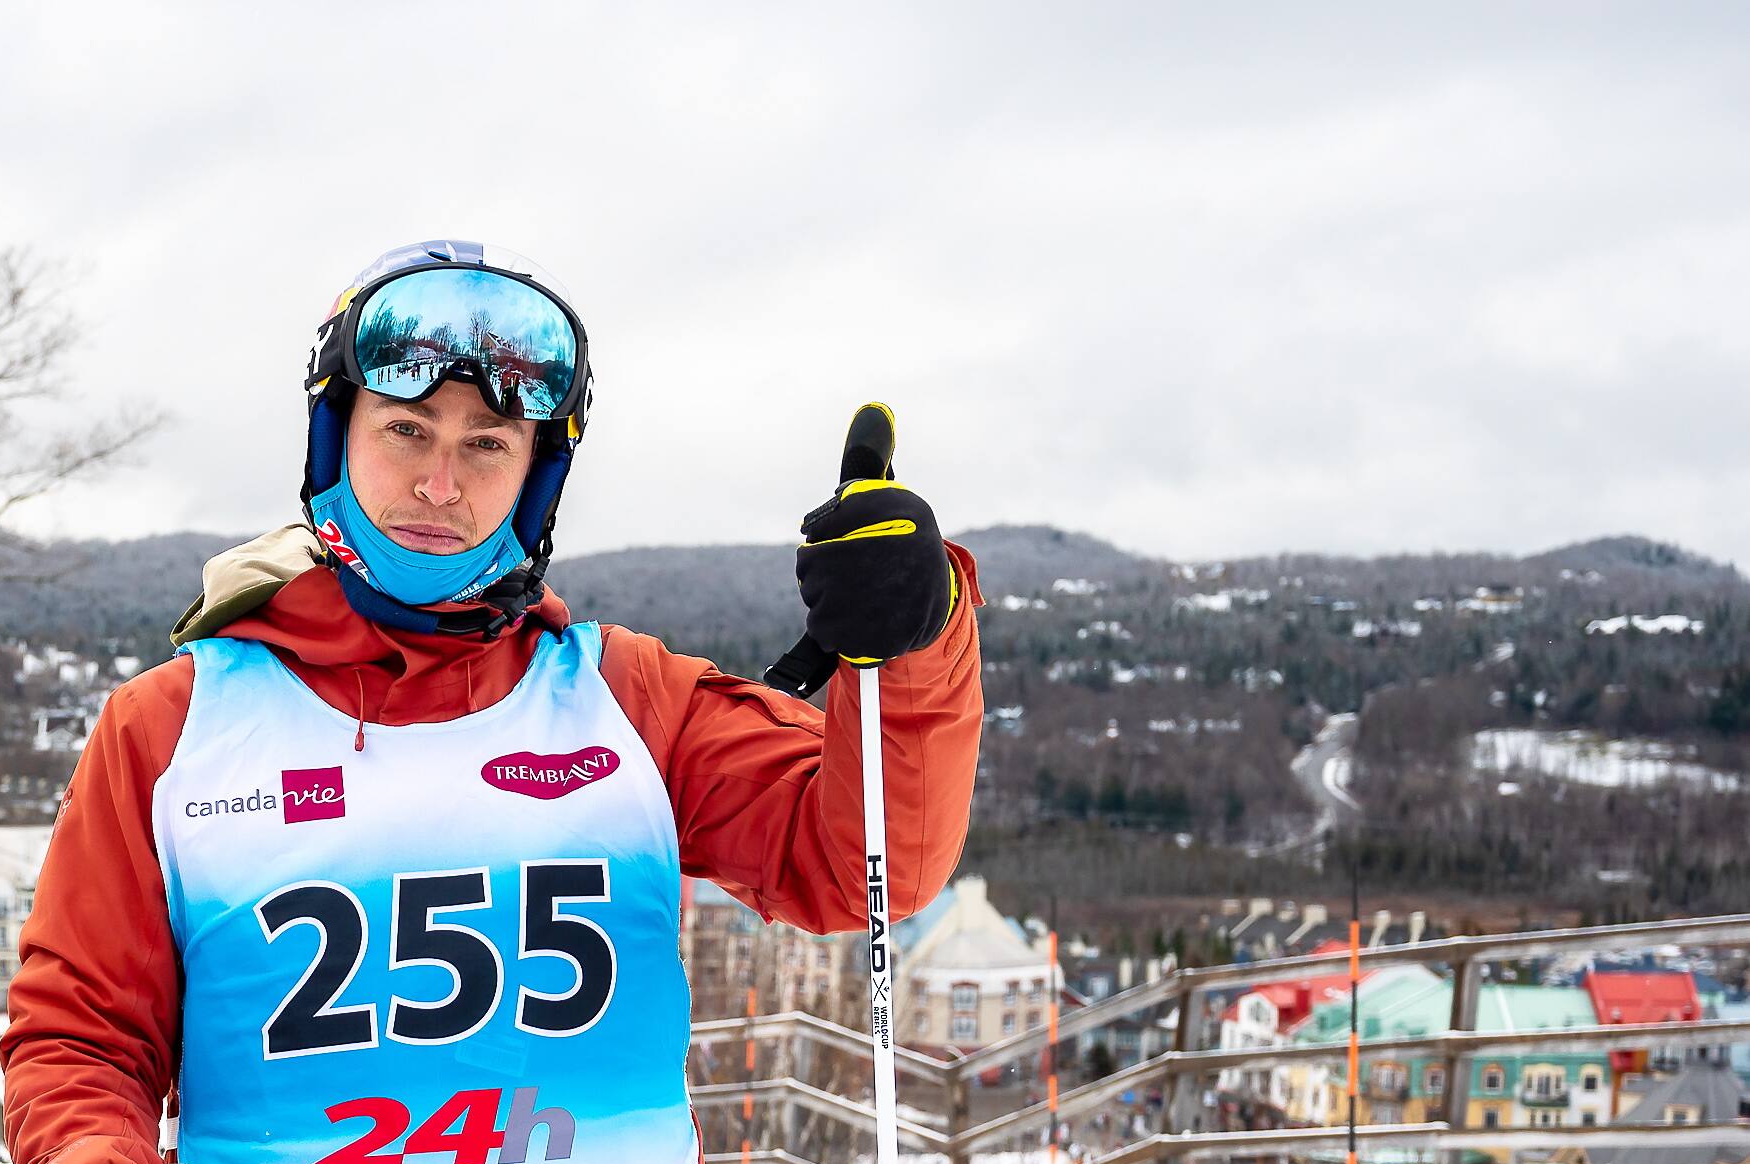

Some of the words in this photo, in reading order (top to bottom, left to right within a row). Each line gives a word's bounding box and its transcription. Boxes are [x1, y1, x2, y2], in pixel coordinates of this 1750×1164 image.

[185, 788, 277, 818] canada
[283, 782, 345, 806] vie
[492, 752, 610, 787] TREMBLANT
[867, 854, 886, 973] HEAD
[252, 857, 618, 1061] 255
